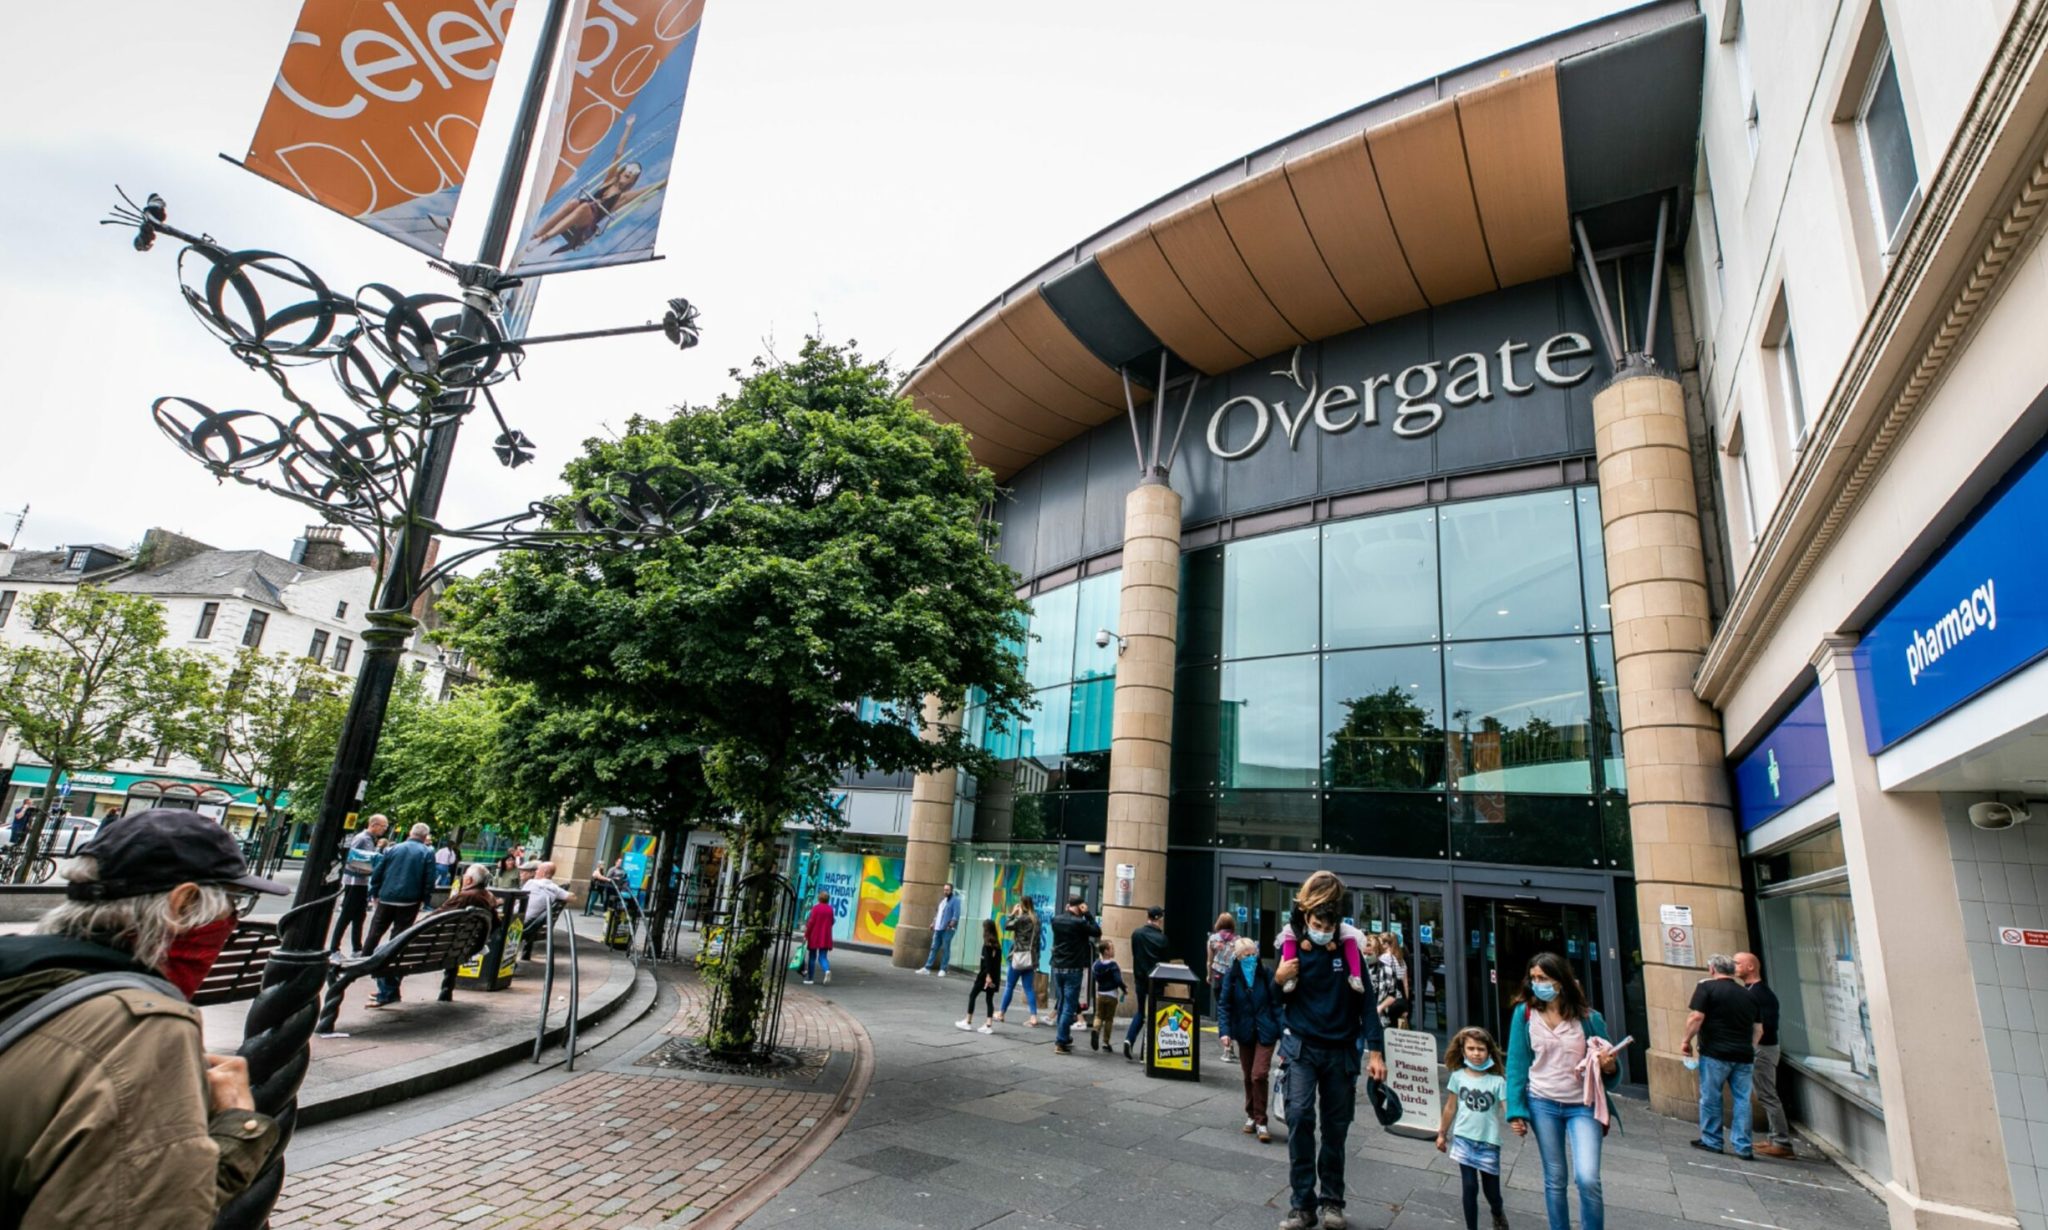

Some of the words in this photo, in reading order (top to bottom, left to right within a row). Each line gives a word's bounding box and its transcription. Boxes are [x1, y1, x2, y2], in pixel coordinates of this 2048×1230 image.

[1206, 332, 1594, 460] Overgate
[1906, 578, 1996, 686] pharmacy
[824, 872, 852, 885] HAPPY
[818, 884, 857, 898] BIRTHDAY
[1395, 1060, 1429, 1073] Please
[1396, 1071, 1408, 1079] do
[1411, 1075, 1429, 1084] not
[1392, 1081, 1413, 1092] feed
[1417, 1085, 1434, 1095] the
[1400, 1093, 1428, 1106] birds
